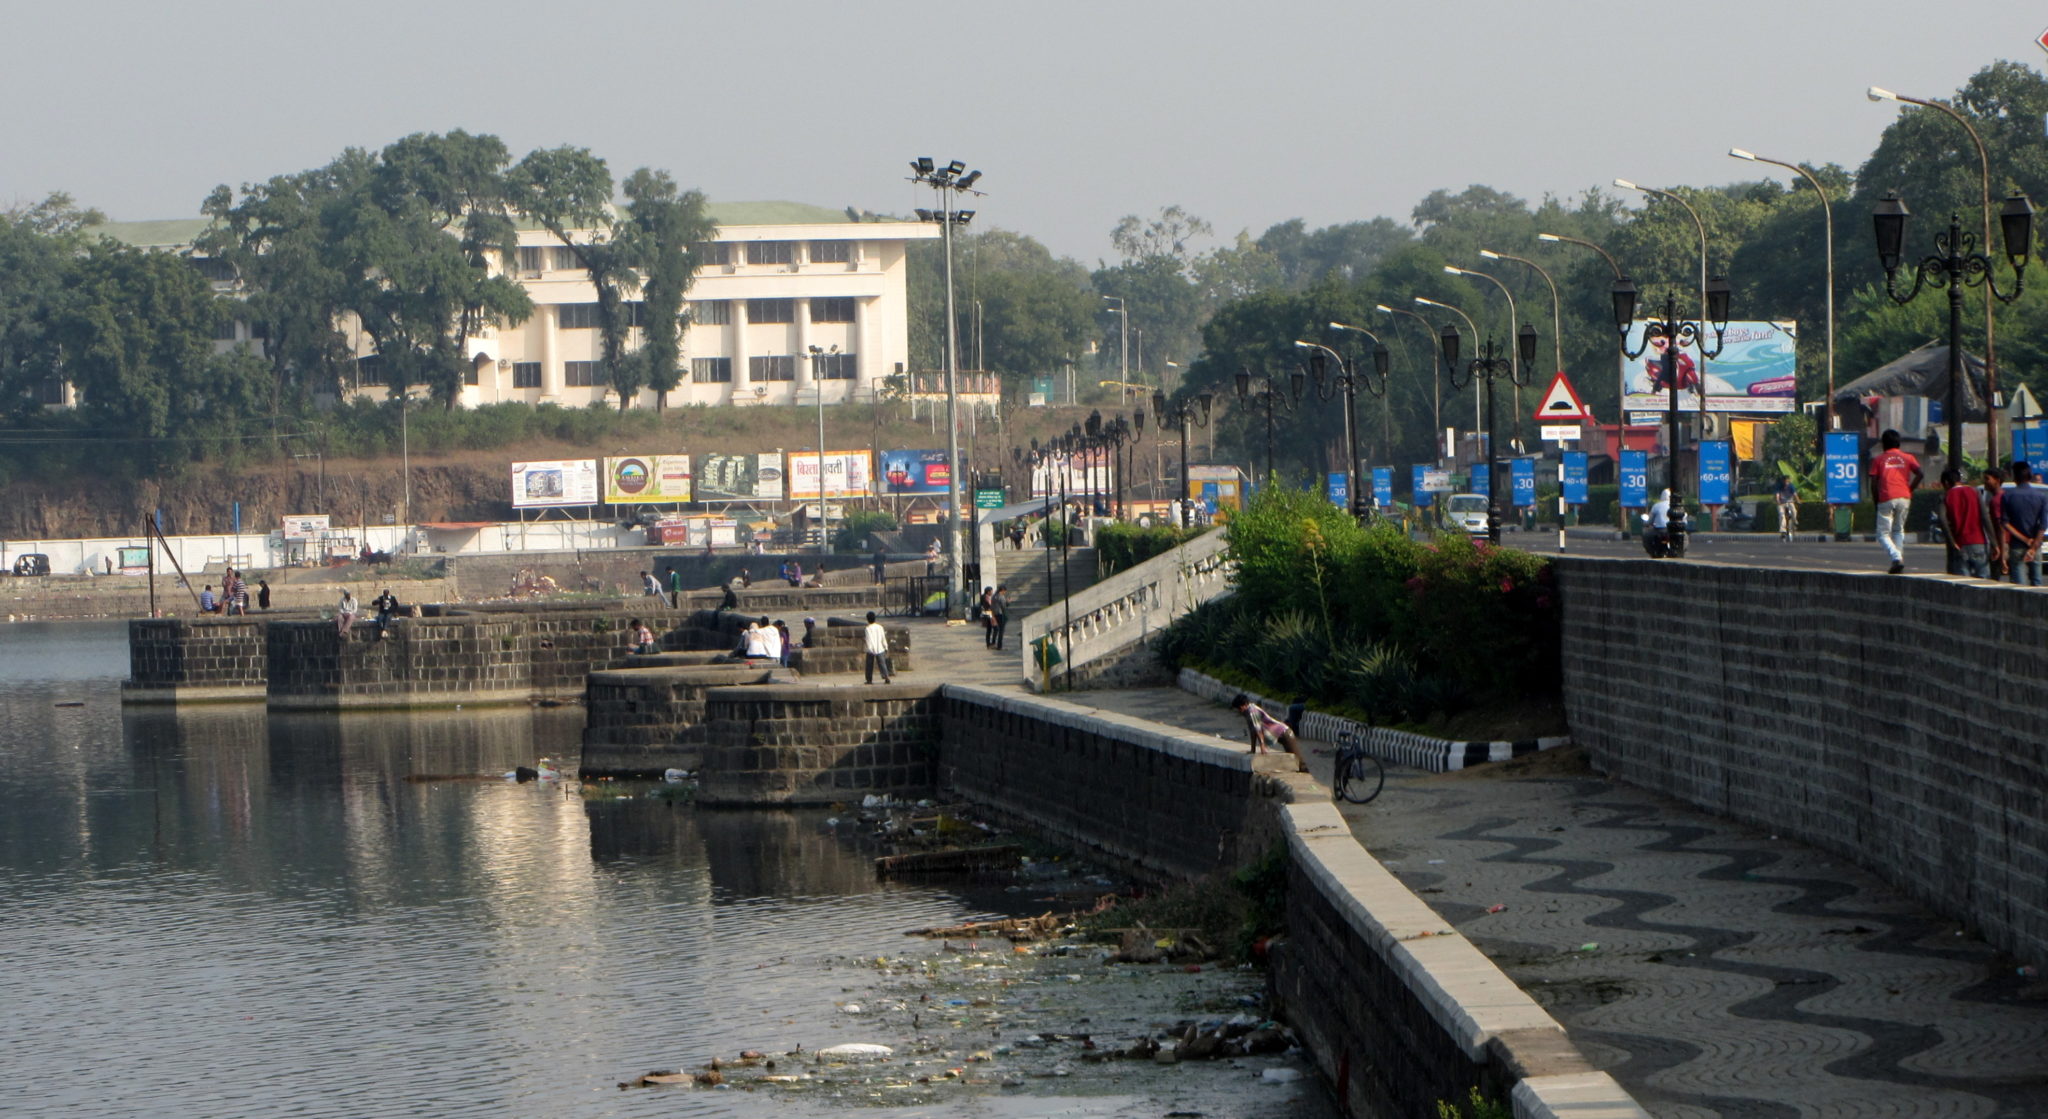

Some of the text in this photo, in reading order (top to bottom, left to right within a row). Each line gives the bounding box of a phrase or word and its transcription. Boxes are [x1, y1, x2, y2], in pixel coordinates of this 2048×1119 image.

[1834, 463, 1858, 480] 30
[1519, 478, 1535, 489] 30
[1628, 475, 1646, 488] 30
